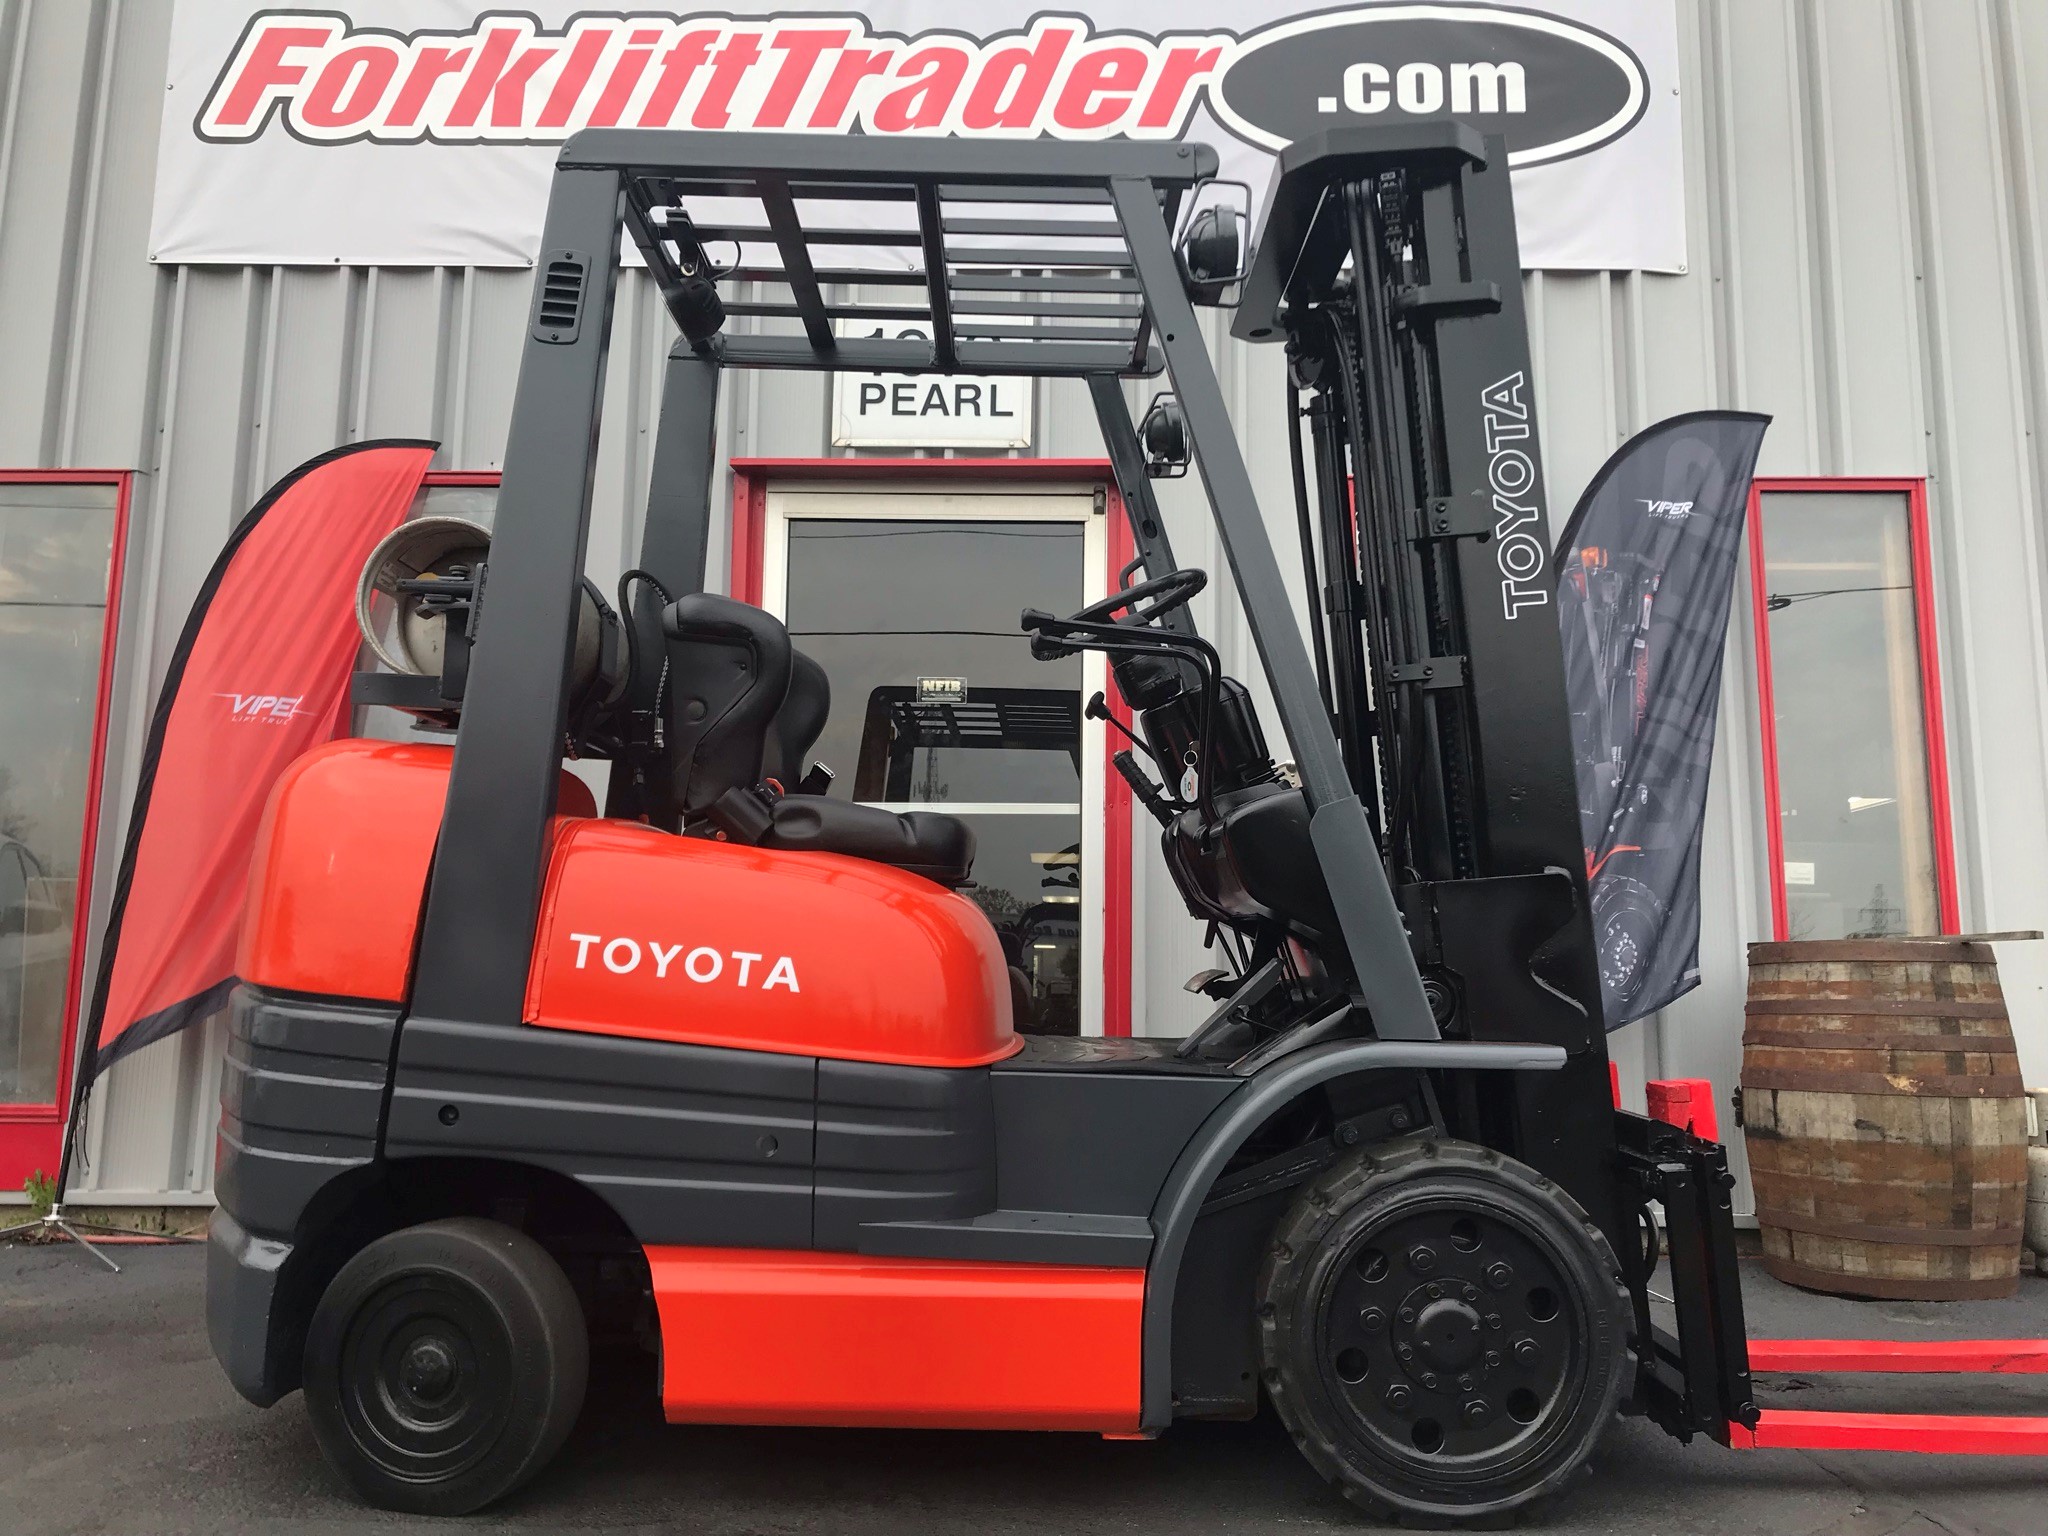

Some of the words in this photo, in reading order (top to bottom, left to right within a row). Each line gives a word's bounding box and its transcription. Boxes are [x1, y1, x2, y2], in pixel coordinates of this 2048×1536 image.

[212, 26, 1225, 131] ForkliftTrader
[1317, 61, 1527, 115] .com
[859, 382, 1014, 417] PEARL
[1480, 370, 1549, 620] TOYOTA
[1644, 500, 1695, 514] VIPER
[569, 932, 801, 994] TOYOTA
